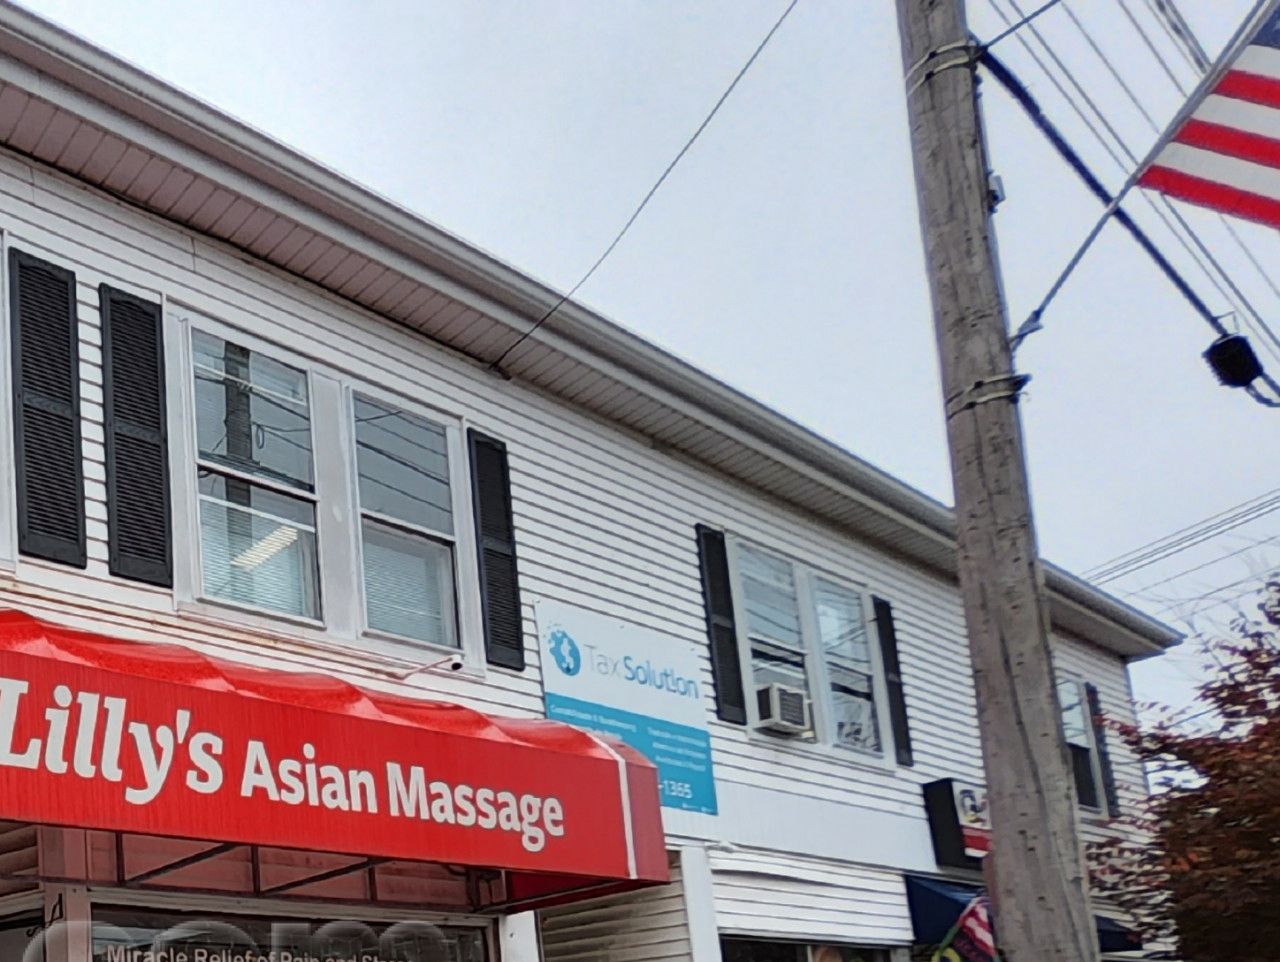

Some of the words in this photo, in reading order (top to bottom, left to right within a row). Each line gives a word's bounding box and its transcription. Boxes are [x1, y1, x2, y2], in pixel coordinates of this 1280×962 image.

[584, 644, 620, 676] Tax
[623, 655, 700, 699] Solution
[240, 740, 378, 814] Asian
[385, 761, 565, 853] Massage
